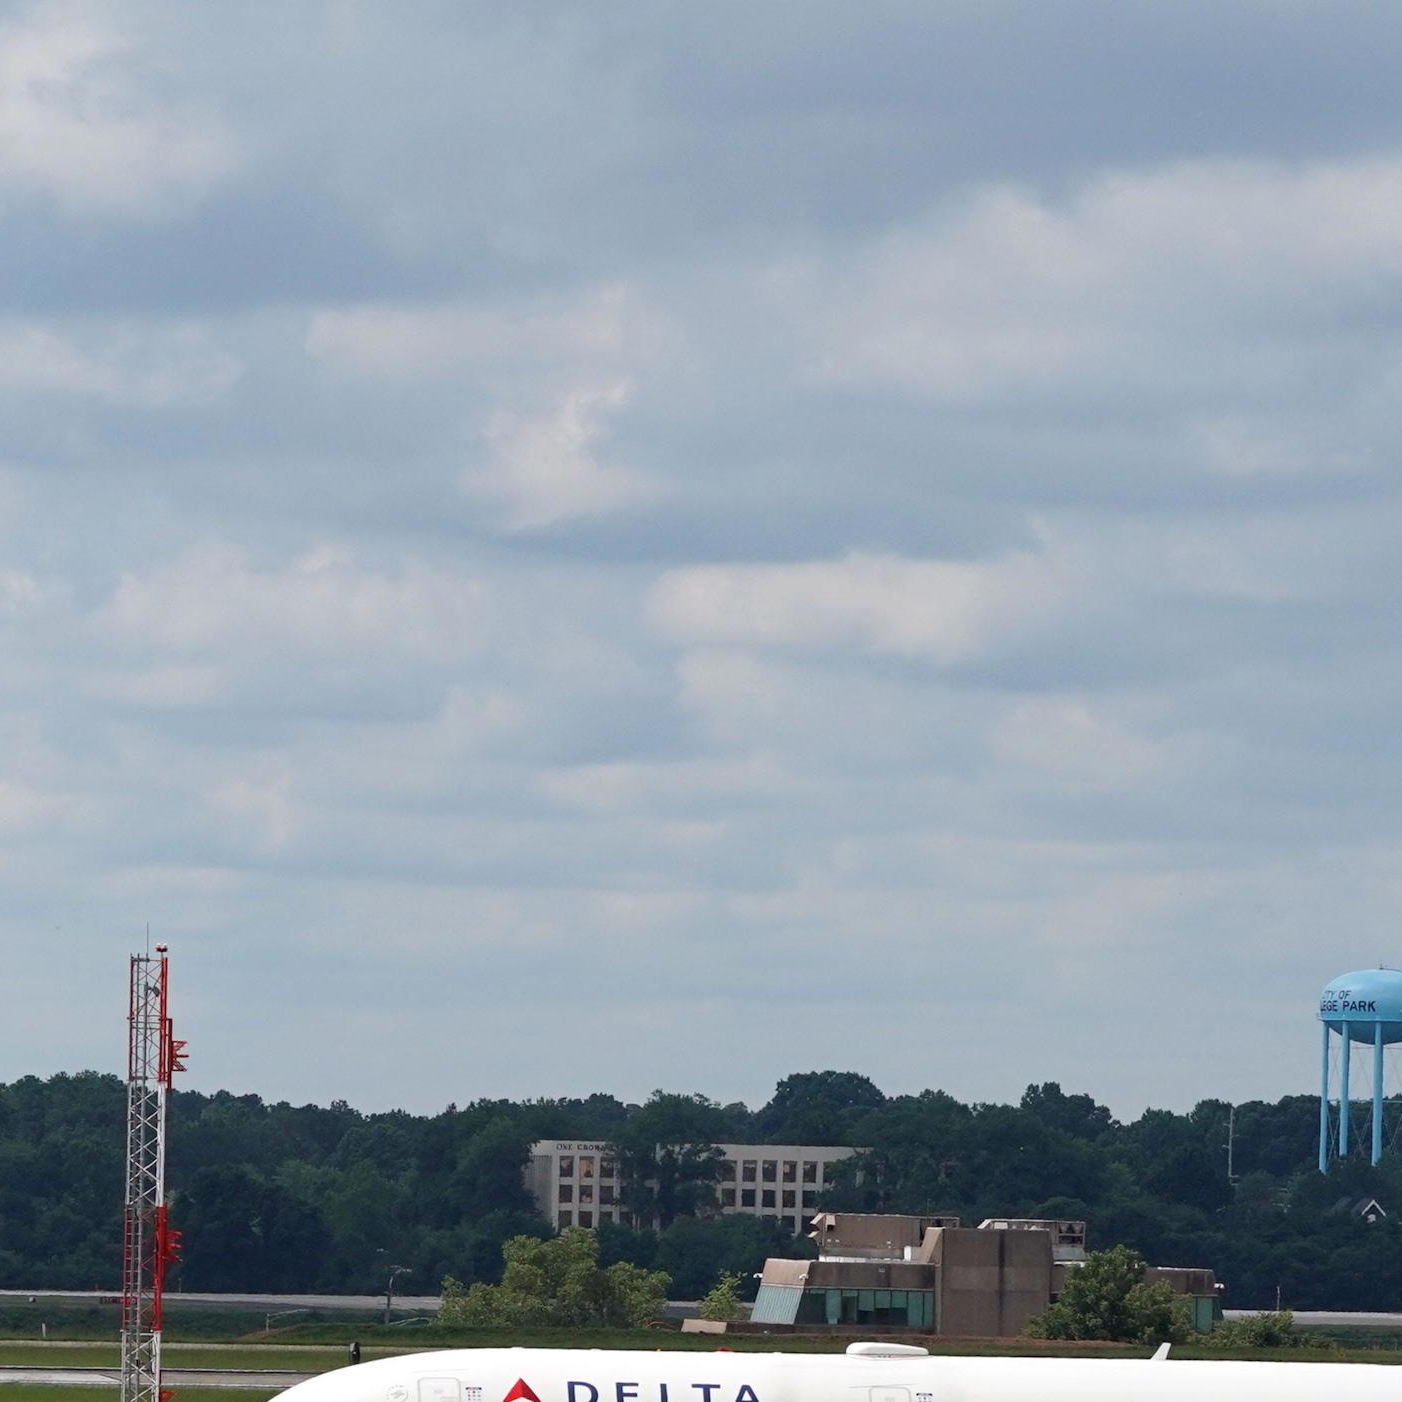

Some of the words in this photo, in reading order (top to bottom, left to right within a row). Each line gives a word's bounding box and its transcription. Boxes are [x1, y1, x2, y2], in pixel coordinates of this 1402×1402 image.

[1339, 990, 1352, 1000] OF
[1342, 1000, 1376, 1013] PARK
[556, 1143, 573, 1151] ONE
